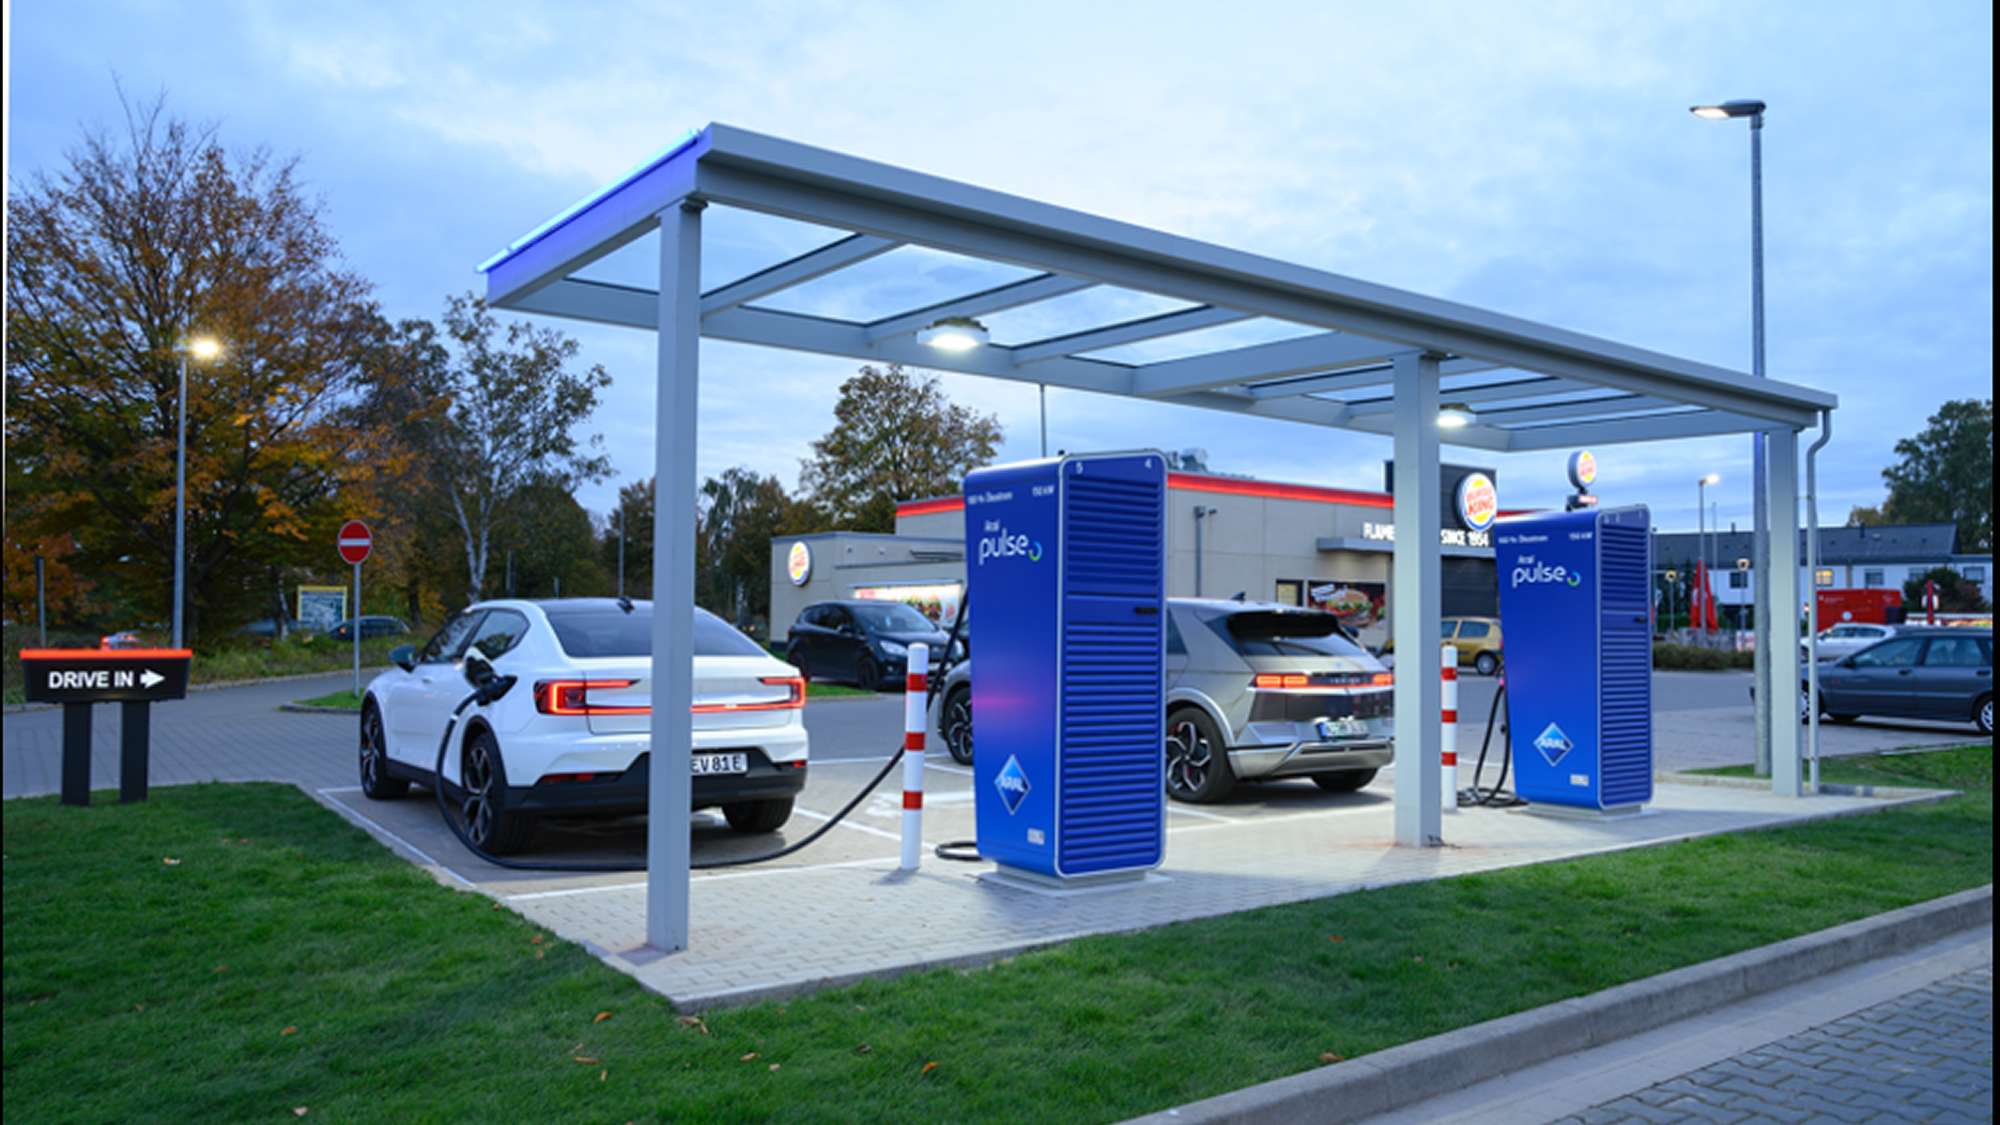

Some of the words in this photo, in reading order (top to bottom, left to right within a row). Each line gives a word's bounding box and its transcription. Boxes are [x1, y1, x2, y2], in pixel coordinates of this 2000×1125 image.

[978, 528, 1029, 566] pulse
[1512, 561, 1567, 588] pulse
[48, 670, 110, 690] DRIVE
[113, 670, 135, 689] IN
